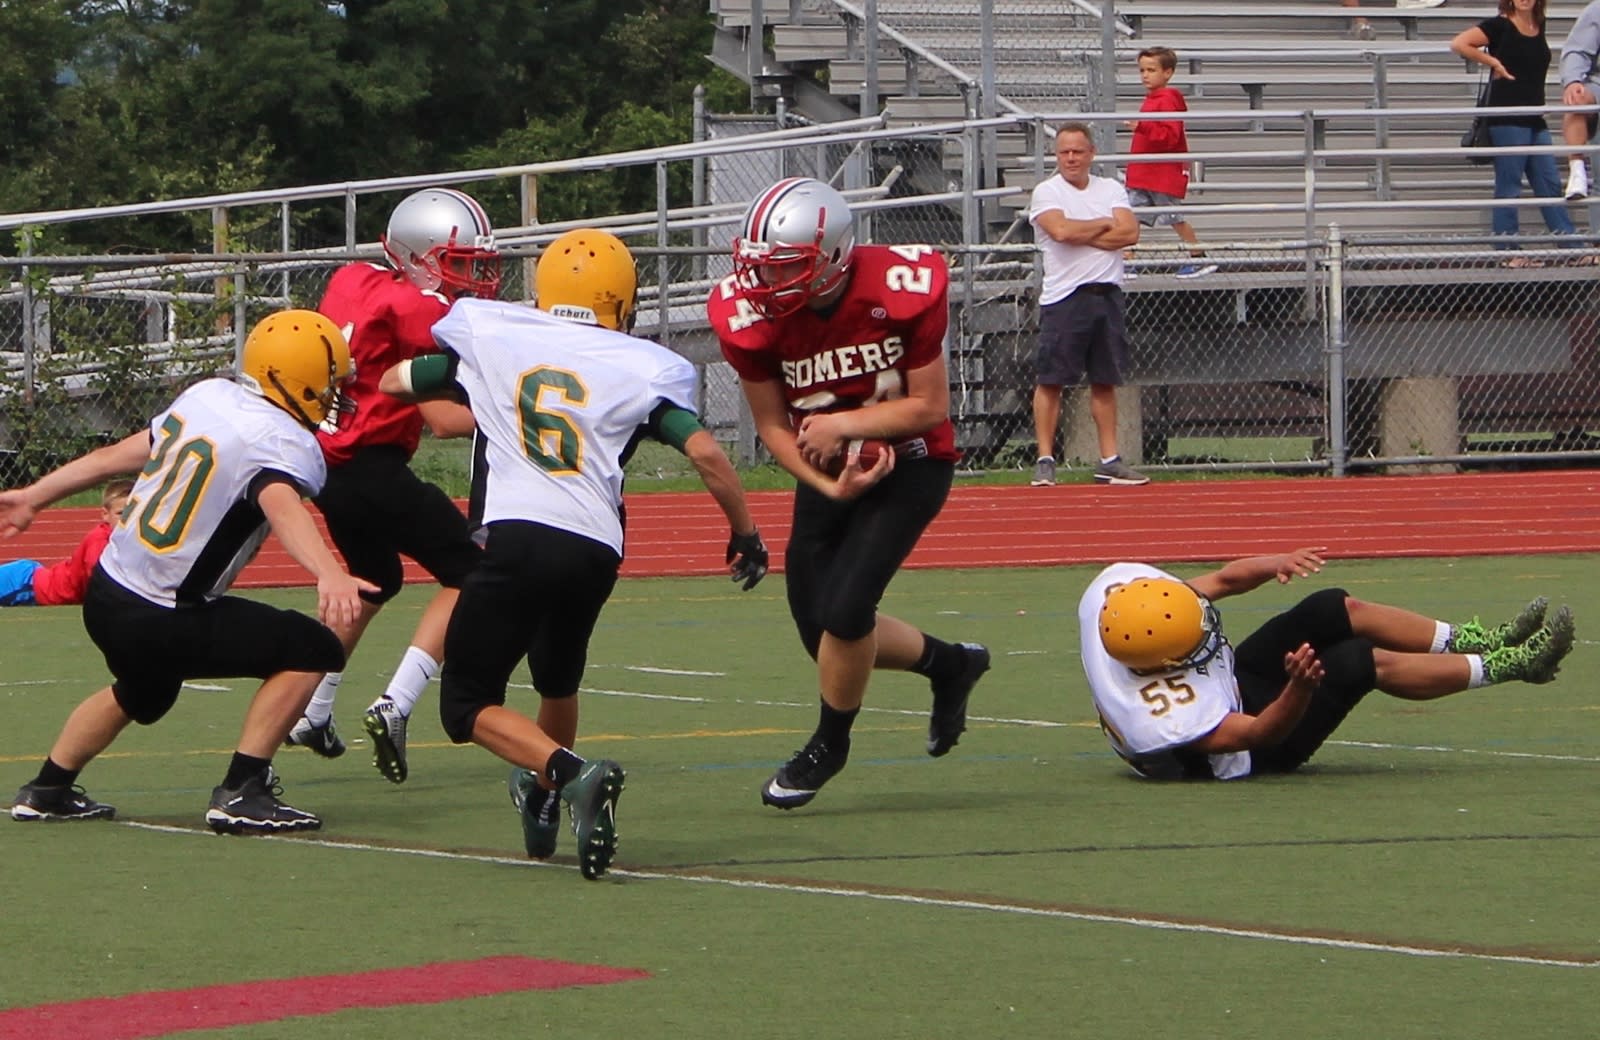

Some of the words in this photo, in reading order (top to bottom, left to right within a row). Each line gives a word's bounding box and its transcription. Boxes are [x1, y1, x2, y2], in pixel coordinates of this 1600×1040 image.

[886, 244, 932, 294] 24
[781, 336, 904, 389] SOMERS
[514, 364, 590, 477] 6
[1139, 674, 1198, 717] 55
